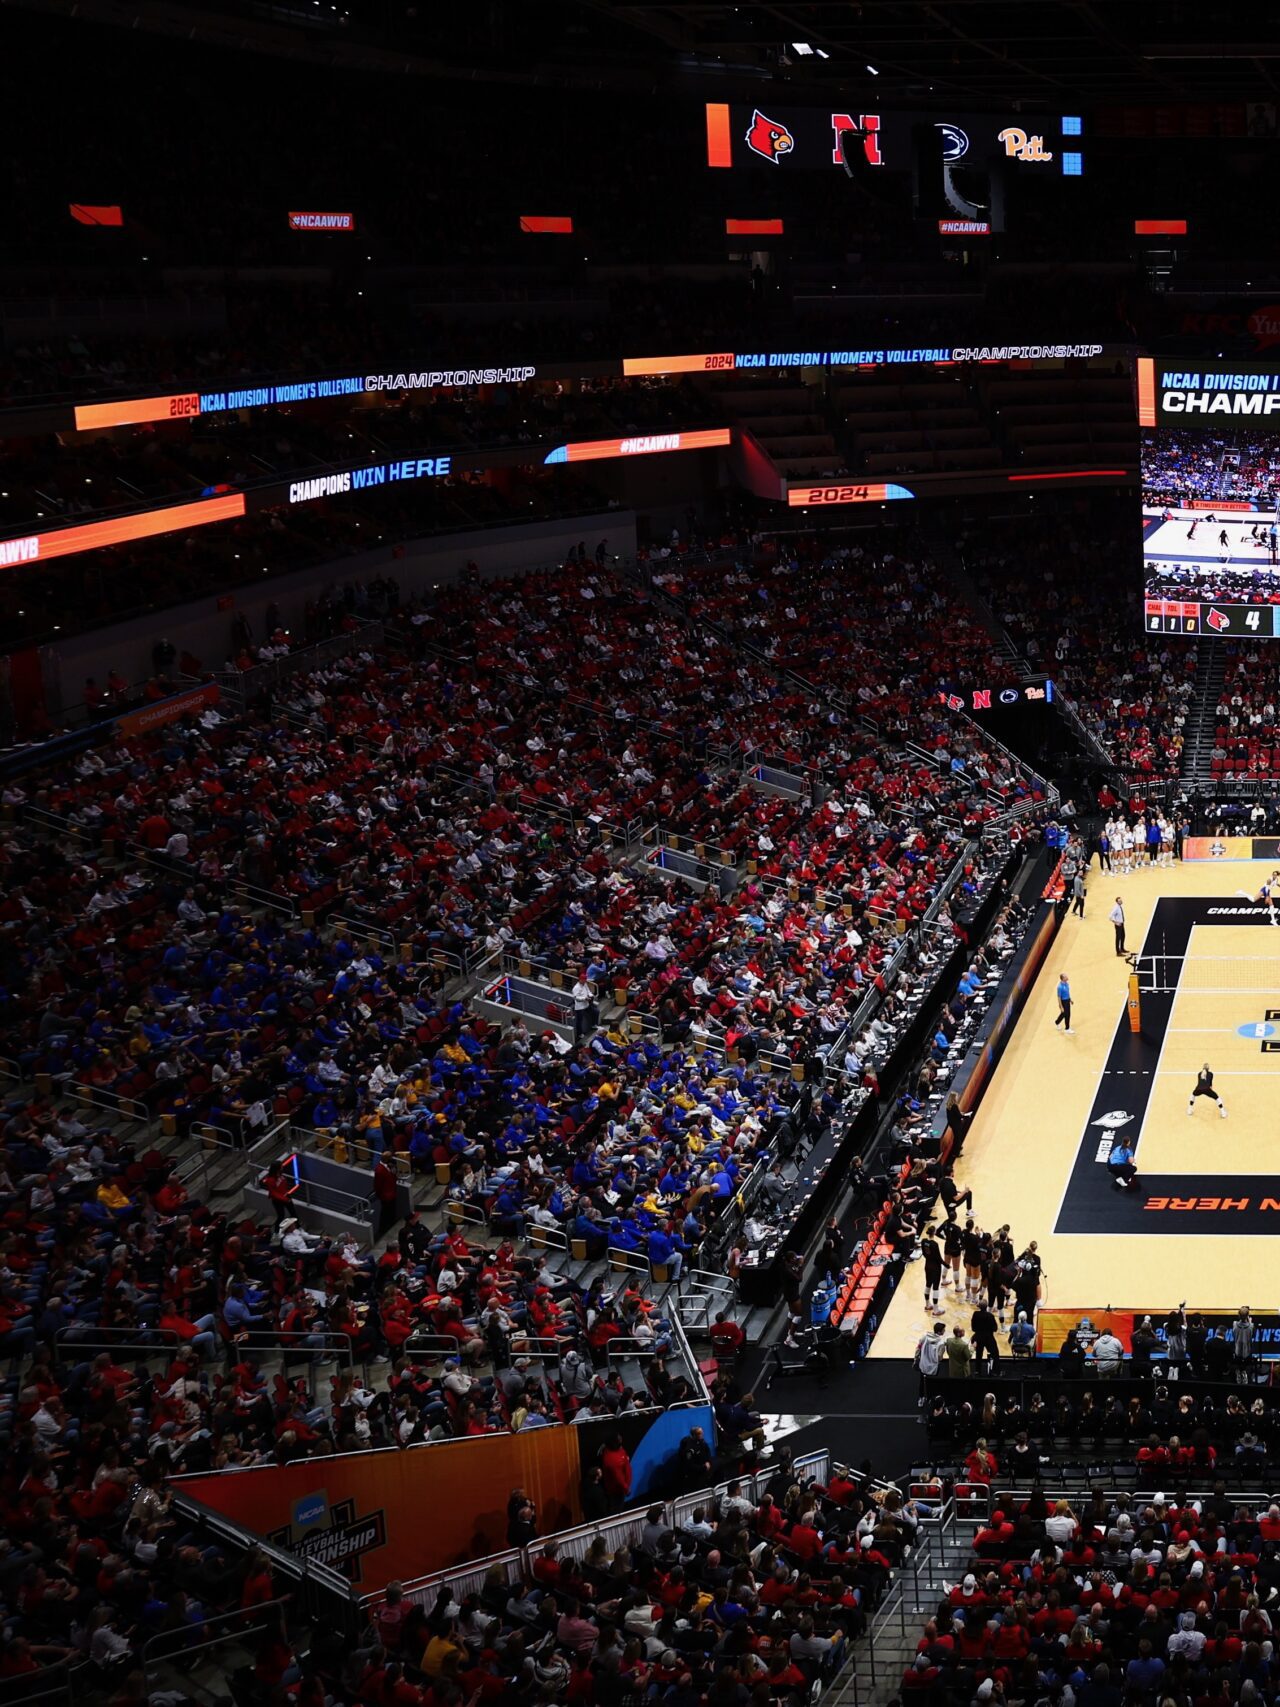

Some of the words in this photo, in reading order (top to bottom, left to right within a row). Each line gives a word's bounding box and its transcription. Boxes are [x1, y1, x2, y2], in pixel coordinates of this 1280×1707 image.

[292, 215, 350, 228] #NCAAWVB
[941, 222, 988, 232] #NCAAWVB
[704, 355, 733, 369] 2024
[735, 353, 767, 368] NCAA
[768, 352, 822, 367] DIVISION
[822, 352, 829, 365] I
[830, 350, 885, 365] WOMEN'S
[886, 348, 951, 363] VOLLEYBALL
[952, 344, 1103, 361] CHAMPIONSHIP
[1161, 372, 1201, 390] NCAA
[1203, 374, 1269, 391] DIVISION
[1271, 375, 1280, 391] I
[170, 396, 199, 417] 2024
[200, 392, 227, 413] NCAA
[228, 386, 270, 410] DIVISION
[275, 382, 317, 404] WOMEN'S
[317, 376, 364, 398] VOLLEYBALL
[365, 366, 536, 392] CHAMPIONSHIP
[619, 434, 681, 454] #NCAAWVB
[289, 473, 351, 504] CHAMPIONS
[352, 465, 386, 490] WIN
[388, 457, 451, 482] HERE
[808, 486, 869, 503] 2024
[1170, 617, 1176, 630] 1
[1245, 610, 1260, 631] 4
[973, 689, 991, 709] N
[1144, 1197, 1250, 1210] HERE
